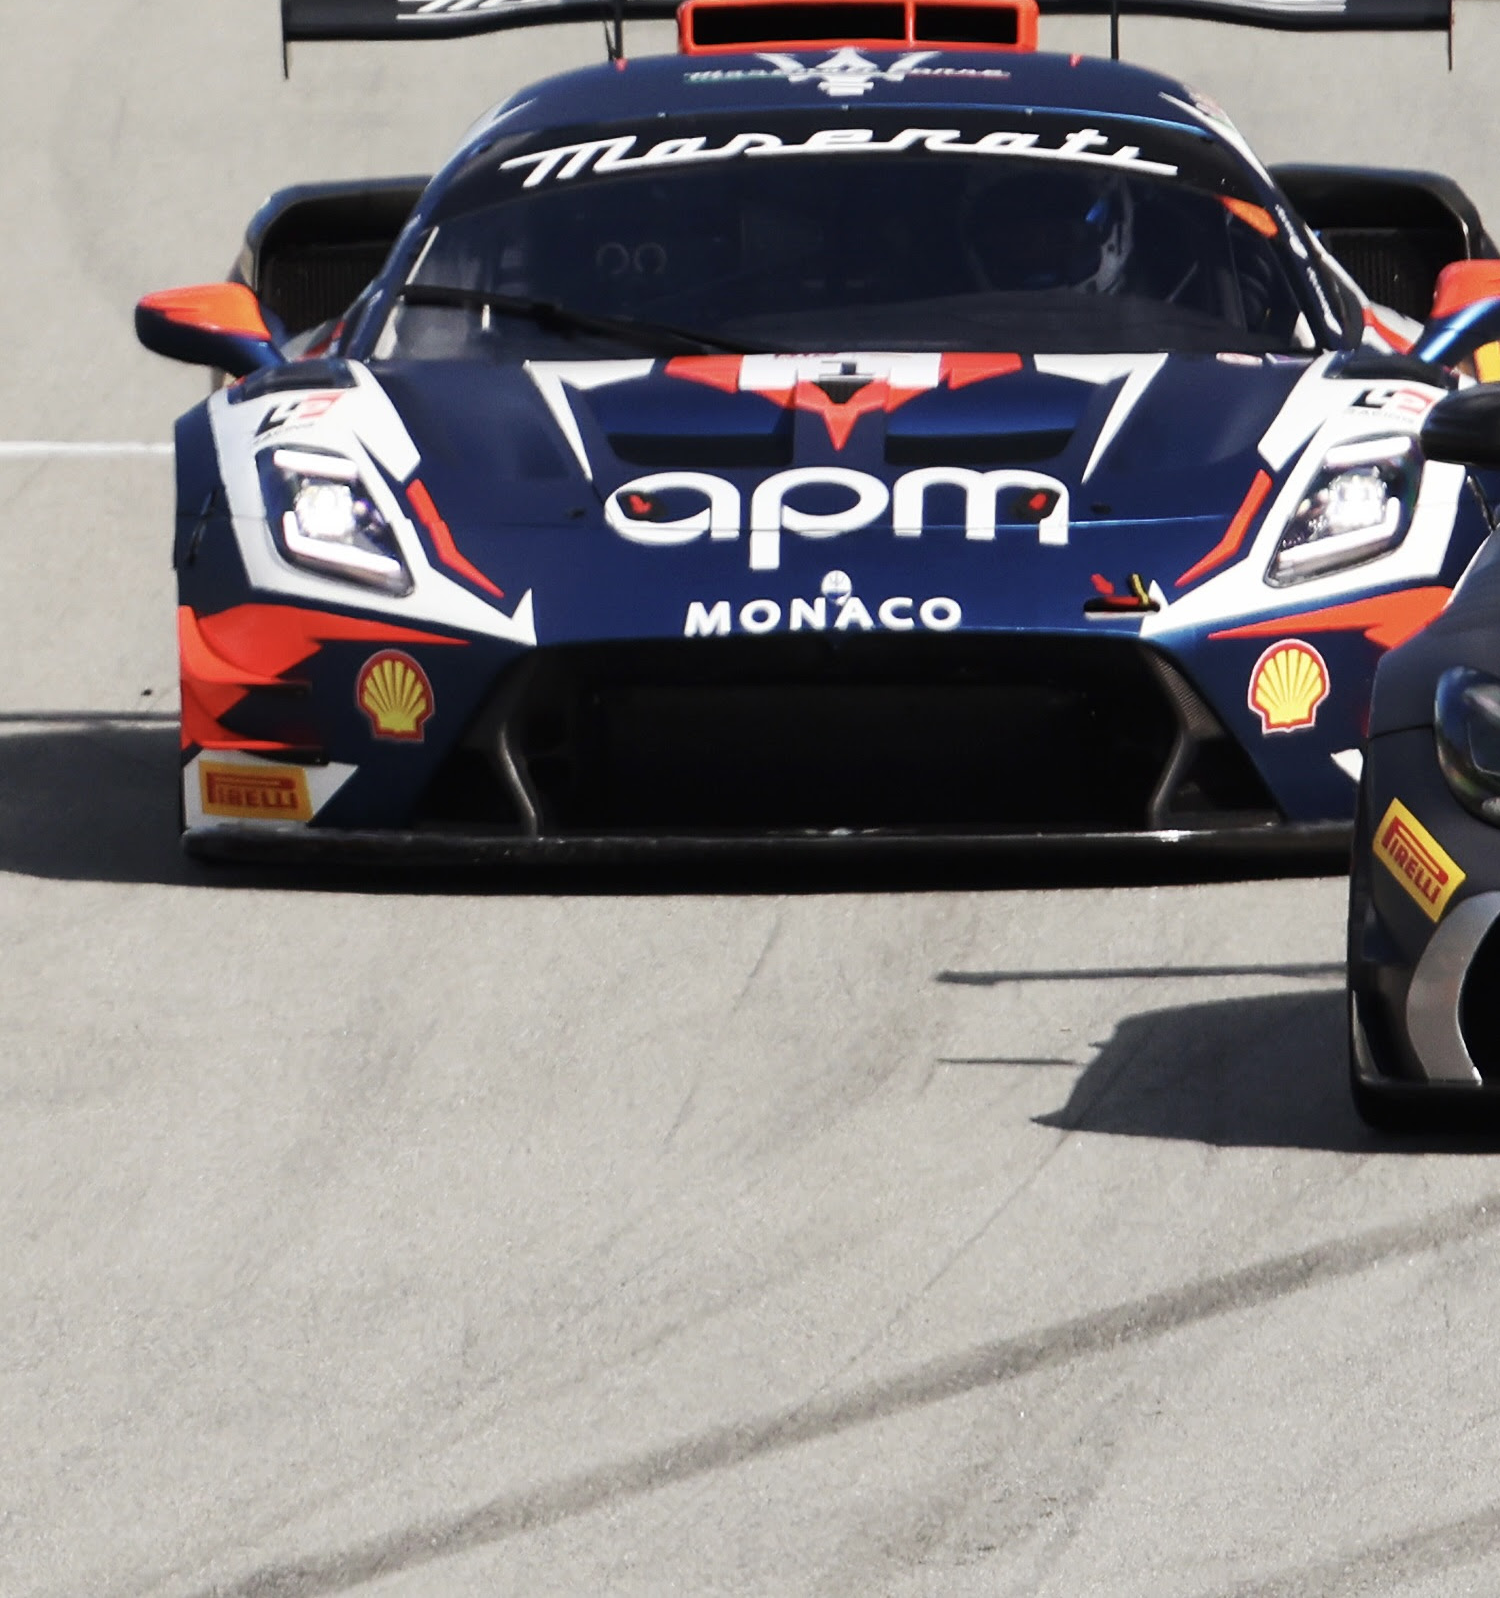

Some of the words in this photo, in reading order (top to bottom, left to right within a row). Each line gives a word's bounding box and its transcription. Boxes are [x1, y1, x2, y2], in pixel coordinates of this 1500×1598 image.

[499, 127, 1178, 189] Maserati
[604, 466, 1070, 571] apm
[683, 596, 963, 638] MONACO
[205, 772, 298, 809] PIRELLI
[1380, 815, 1450, 905] PIRELLI
